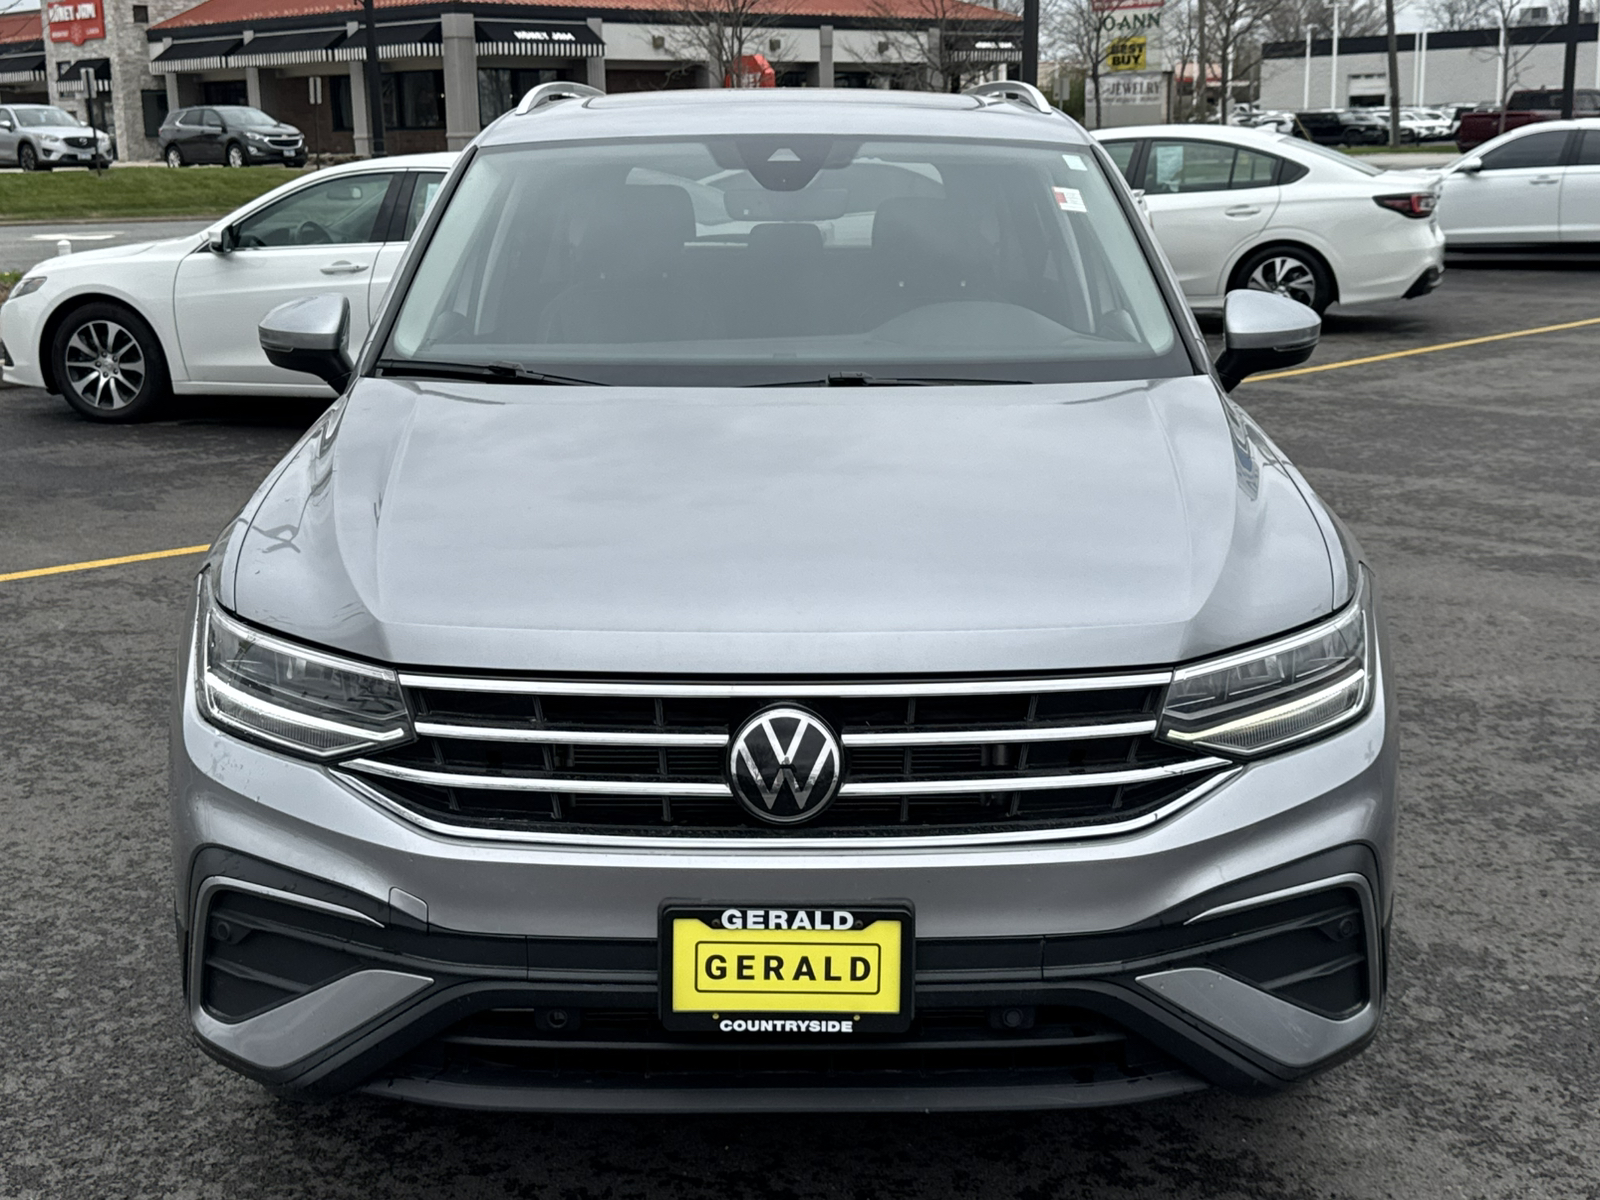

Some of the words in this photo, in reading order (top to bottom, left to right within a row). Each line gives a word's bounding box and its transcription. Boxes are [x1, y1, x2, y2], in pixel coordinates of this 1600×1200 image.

[1112, 54, 1141, 66] BUY
[1110, 81, 1160, 95] JEWELRY
[721, 908, 854, 931] GERALD
[704, 954, 871, 981] GERALD
[719, 1019, 853, 1033] COUNTRYSIDE
